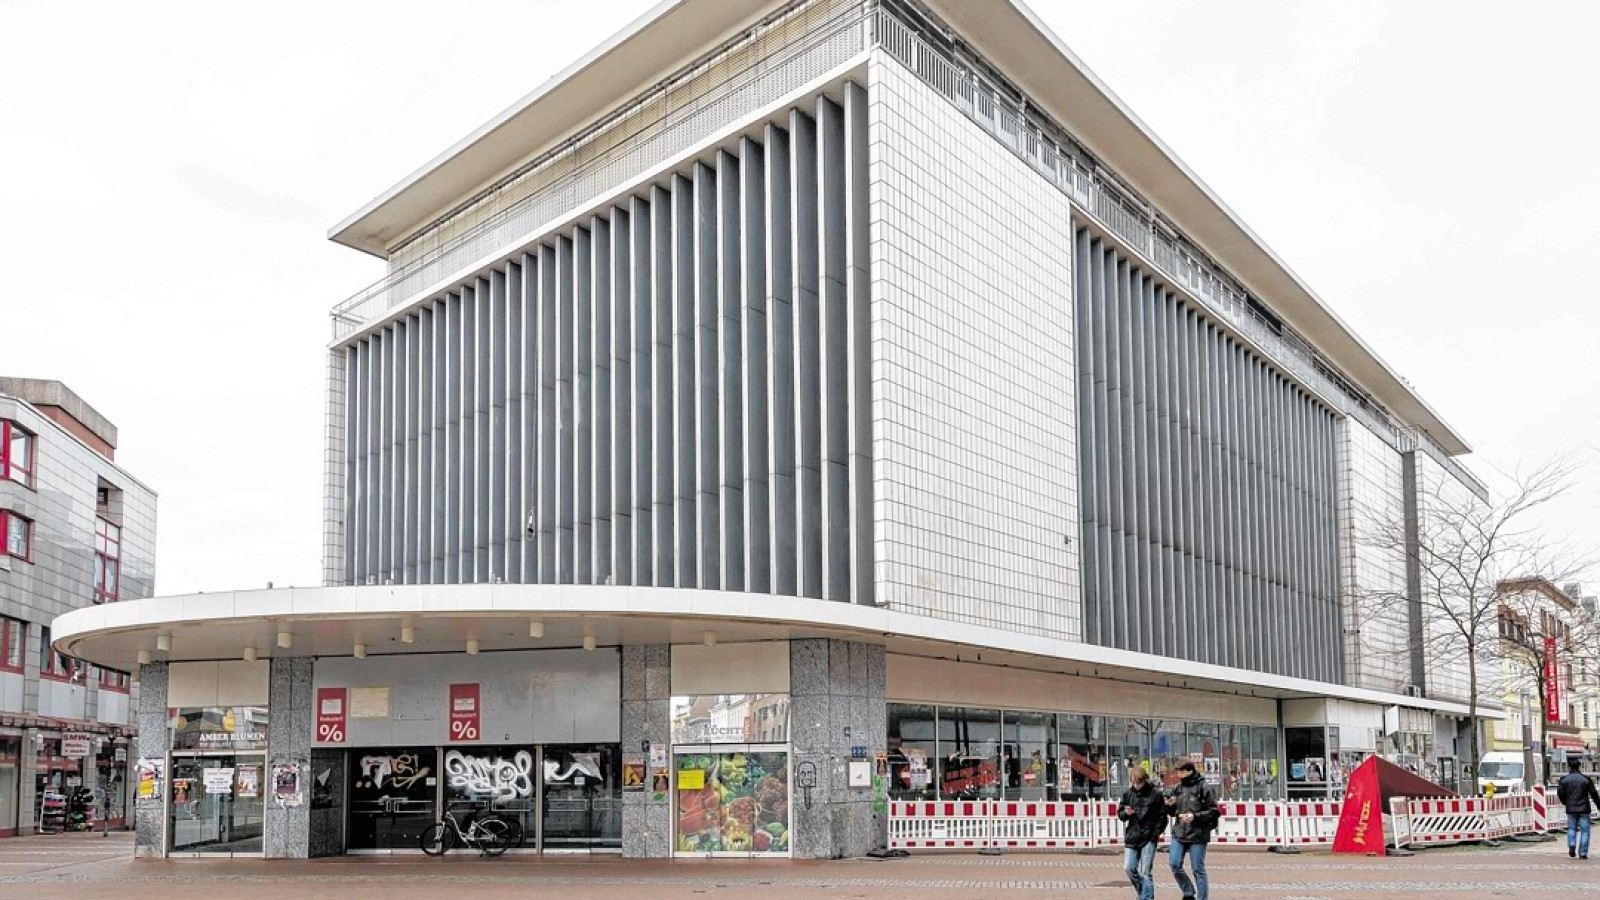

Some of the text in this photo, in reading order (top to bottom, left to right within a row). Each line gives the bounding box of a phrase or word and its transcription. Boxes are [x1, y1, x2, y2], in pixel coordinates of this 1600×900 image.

[199, 732, 265, 741] AMBER BLUMEN
[320, 724, 343, 741] %
[452, 720, 477, 739] %
